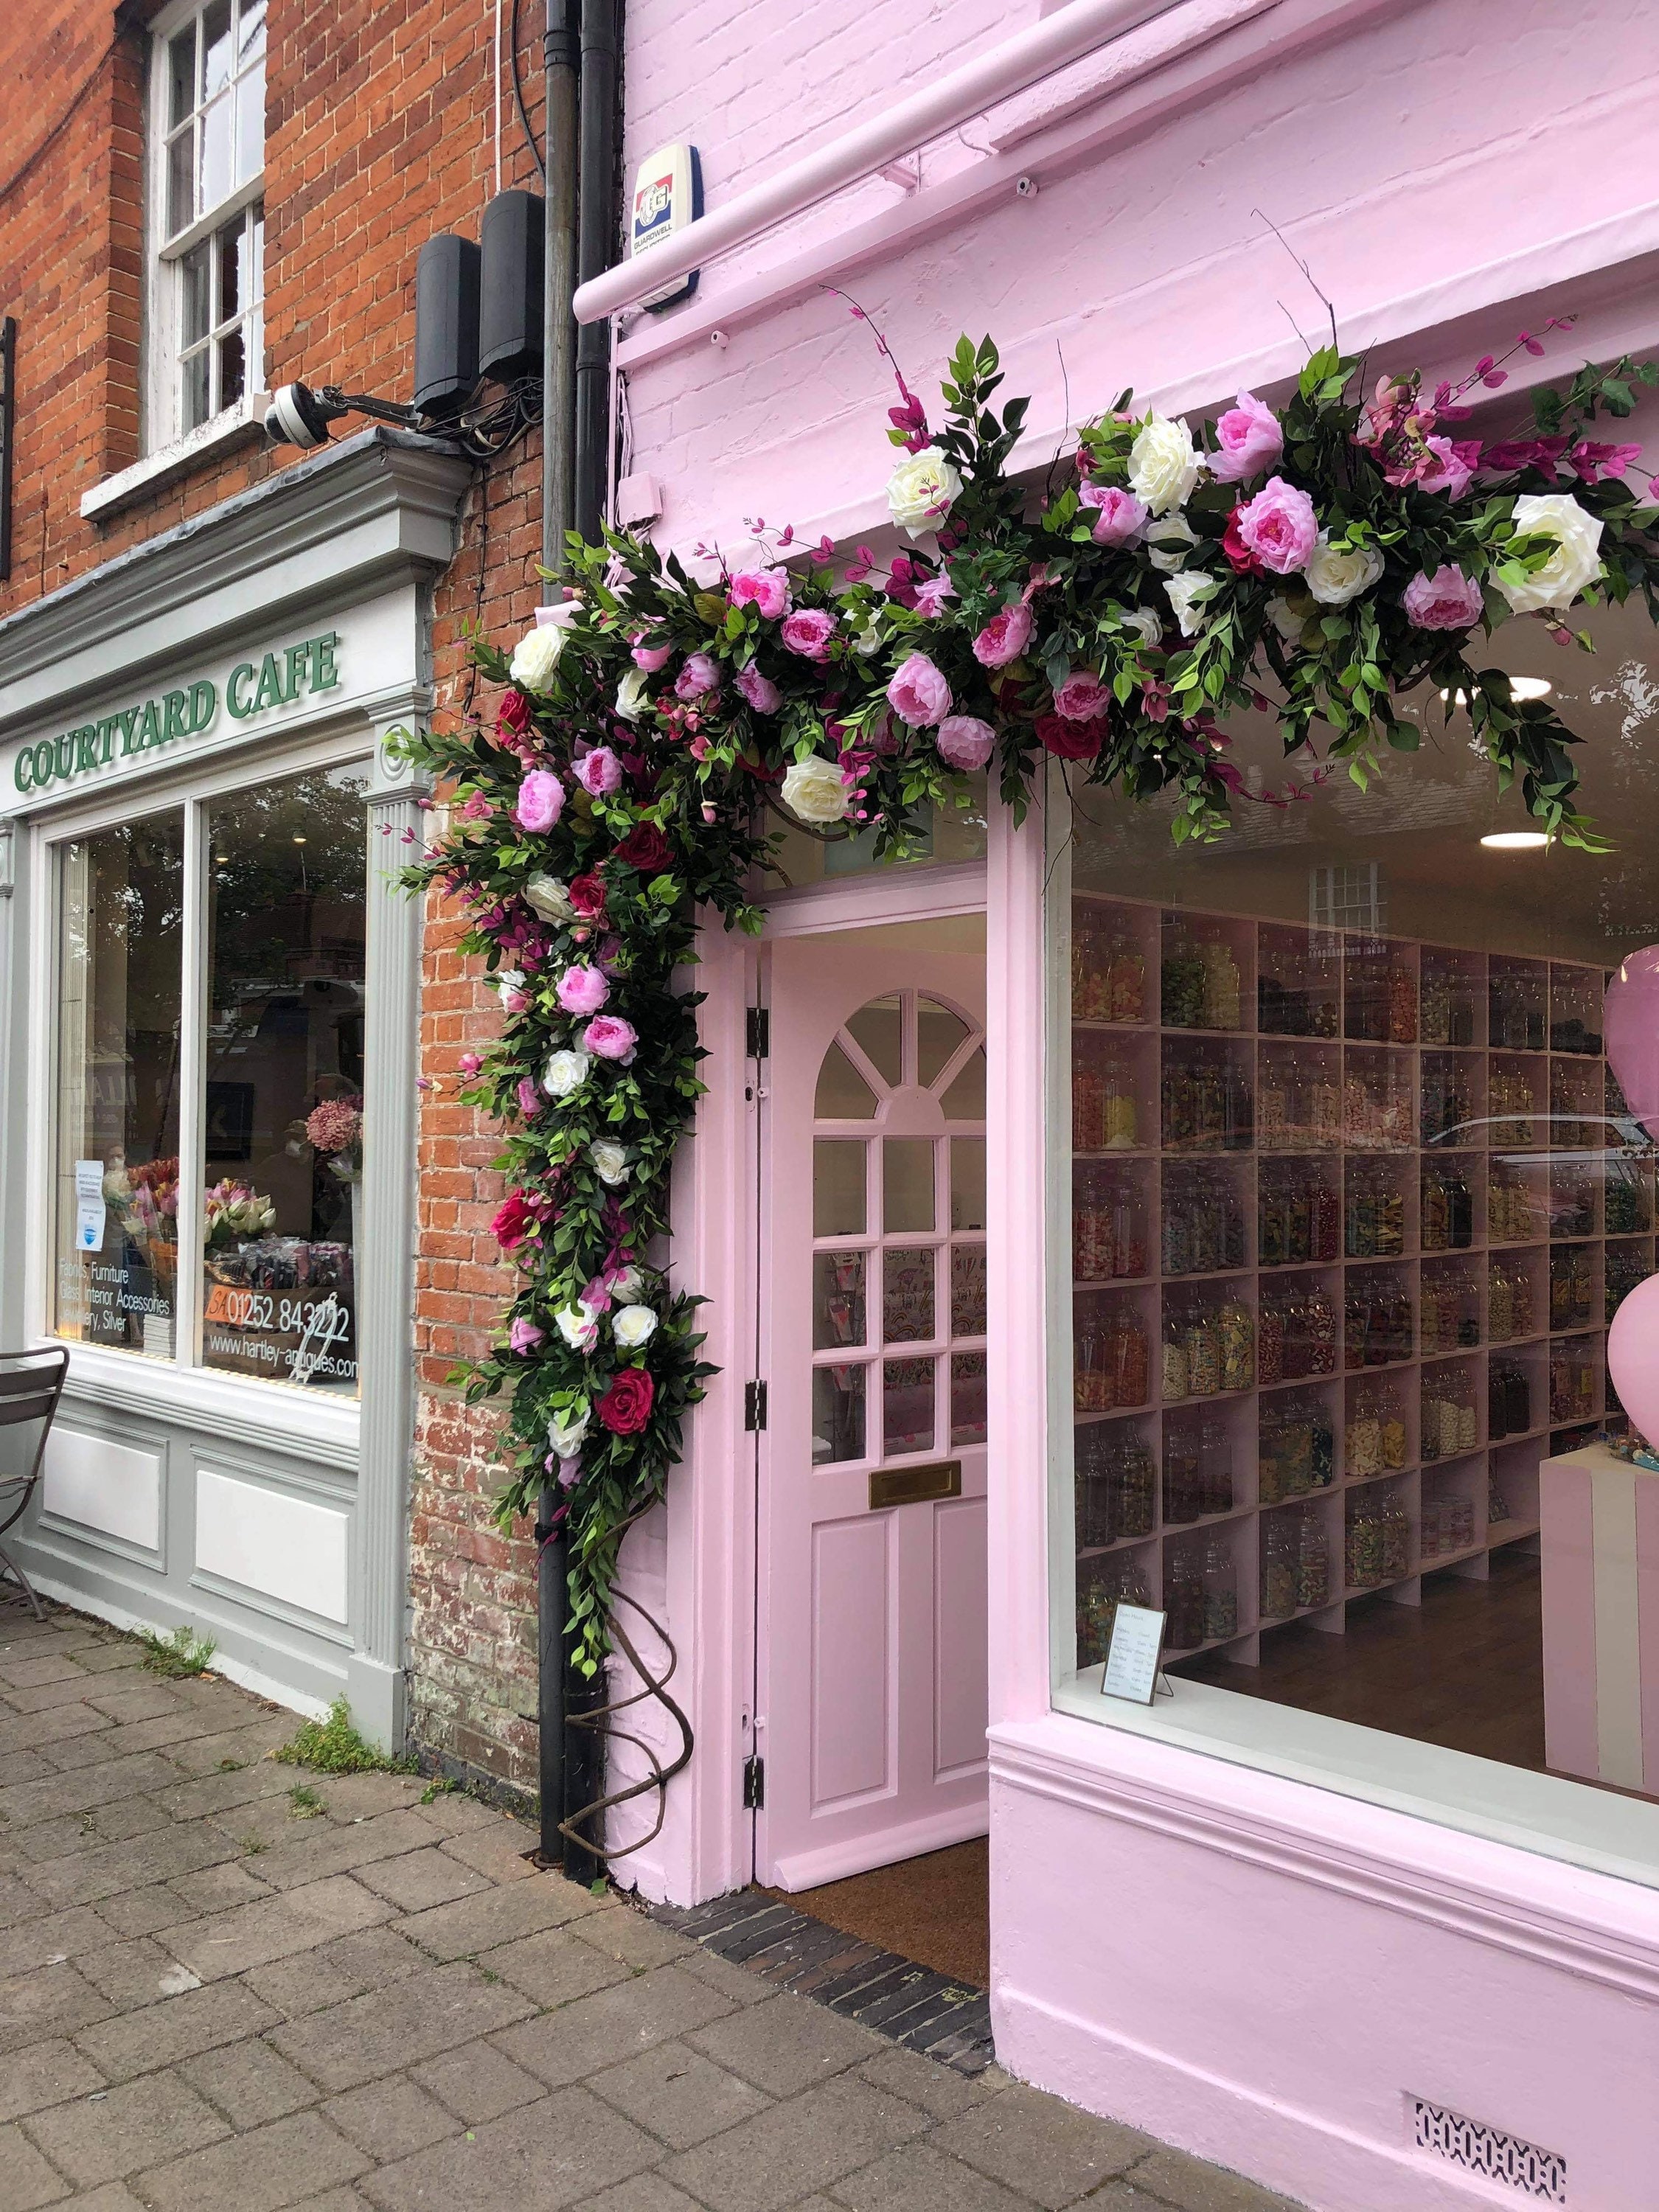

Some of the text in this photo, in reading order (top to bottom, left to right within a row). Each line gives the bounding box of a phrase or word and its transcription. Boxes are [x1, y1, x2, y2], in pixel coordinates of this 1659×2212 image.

[634, 223, 672, 249] GUARDWELL
[14, 630, 339, 792] COURTYARD CAFE
[91, 1261, 129, 1284] Furniture
[84, 1284, 114, 1306] Interior
[116, 1288, 170, 1315] Accessories
[227, 1291, 274, 1329] 01252
[102, 1310, 127, 1332] Silver
